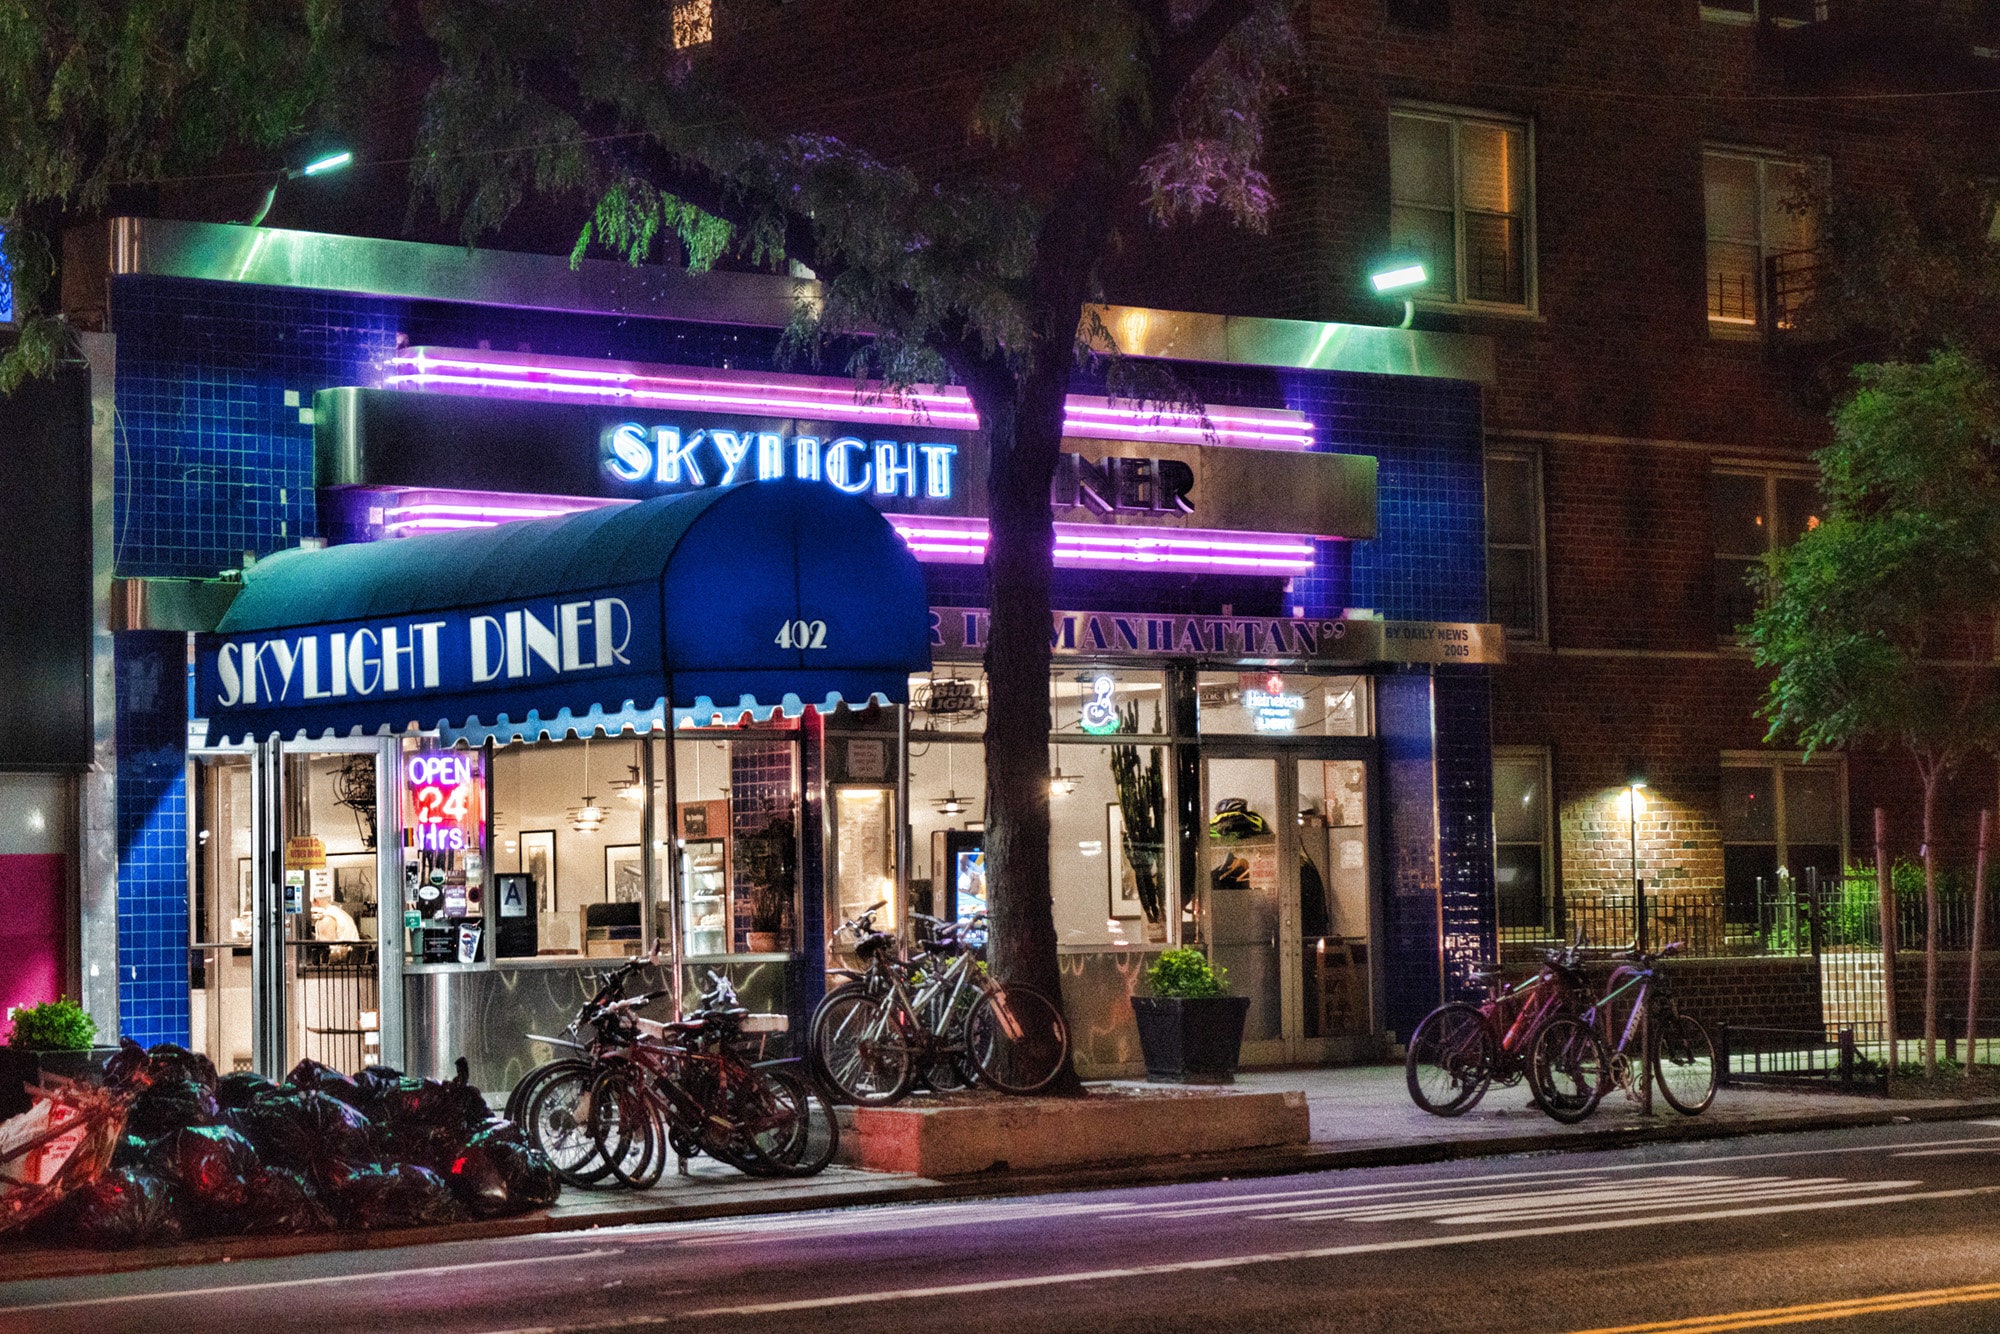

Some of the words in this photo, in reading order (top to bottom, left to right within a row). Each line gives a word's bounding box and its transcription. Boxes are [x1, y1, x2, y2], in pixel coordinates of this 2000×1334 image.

[605, 422, 957, 498] SKYLIGHT
[1051, 452, 1195, 513] INER
[774, 619, 827, 649] 402
[1404, 628, 1434, 639] DAILY
[1438, 629, 1468, 641] NEWS
[217, 622, 446, 706] SKYLIGHT
[470, 598, 631, 682] DINER
[1444, 645, 1469, 656] 2005
[934, 683, 976, 698] BUD
[409, 757, 471, 785] OPEN
[419, 785, 468, 823] 24
[418, 823, 469, 851] Hrs.
[504, 882, 522, 906] A
